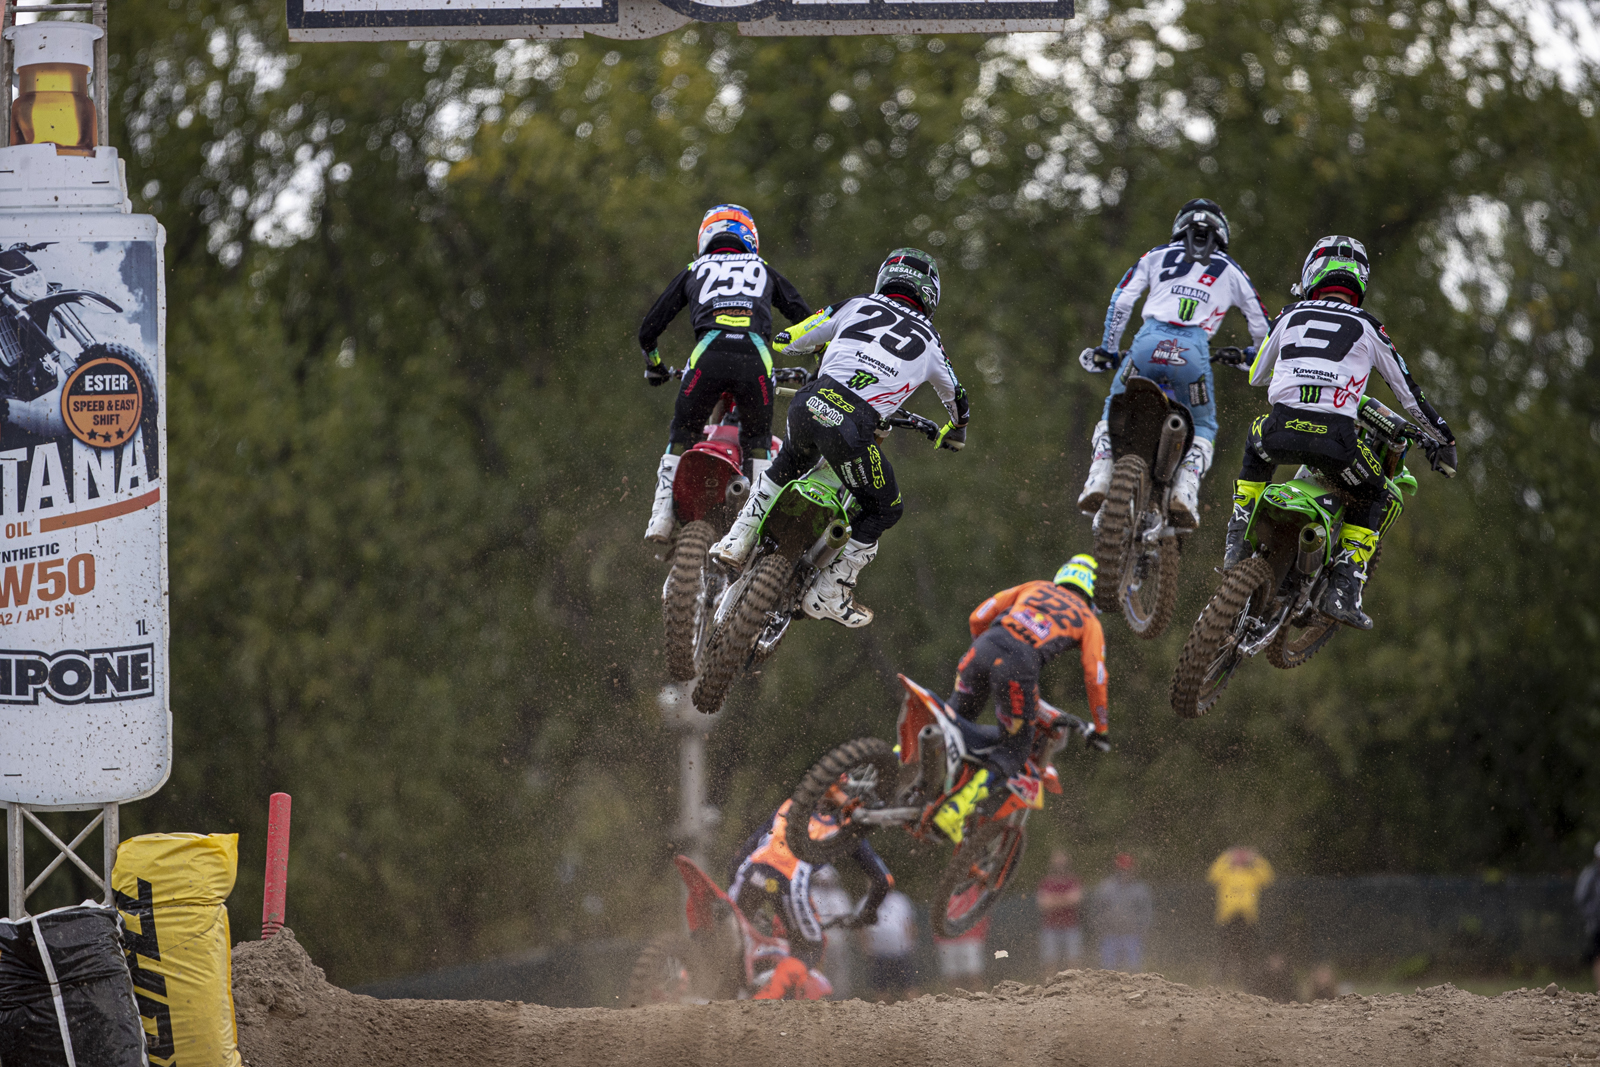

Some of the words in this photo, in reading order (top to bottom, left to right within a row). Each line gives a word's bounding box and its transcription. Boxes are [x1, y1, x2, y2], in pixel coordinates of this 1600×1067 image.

[696, 260, 768, 305] 259
[888, 266, 924, 279] DESALLE
[1172, 286, 1210, 302] YAMAHA
[868, 293, 932, 327] DESALLE
[838, 304, 933, 361] 25
[1280, 311, 1364, 363] 3
[854, 351, 900, 378] Kawasaki
[1153, 350, 1179, 361] NINJA
[84, 374, 129, 392] ESTER
[1292, 367, 1339, 380] Kawasaki
[1317, 375, 1333, 383] Team
[73, 400, 105, 412] SPEED
[106, 400, 114, 412] &
[115, 399, 136, 411] EASY
[93, 414, 121, 426] SHIFT
[1364, 405, 1396, 430] RENTHAL
[0, 424, 154, 516] TANA
[5, 521, 32, 539] OIL
[0, 542, 60, 563] NTHETIC
[0, 553, 96, 609] W50
[26, 607, 50, 622] API
[54, 602, 75, 617] SN
[1023, 590, 1084, 631] 222
[135, 619, 148, 636] 1L
[0, 649, 152, 700] IPONE
